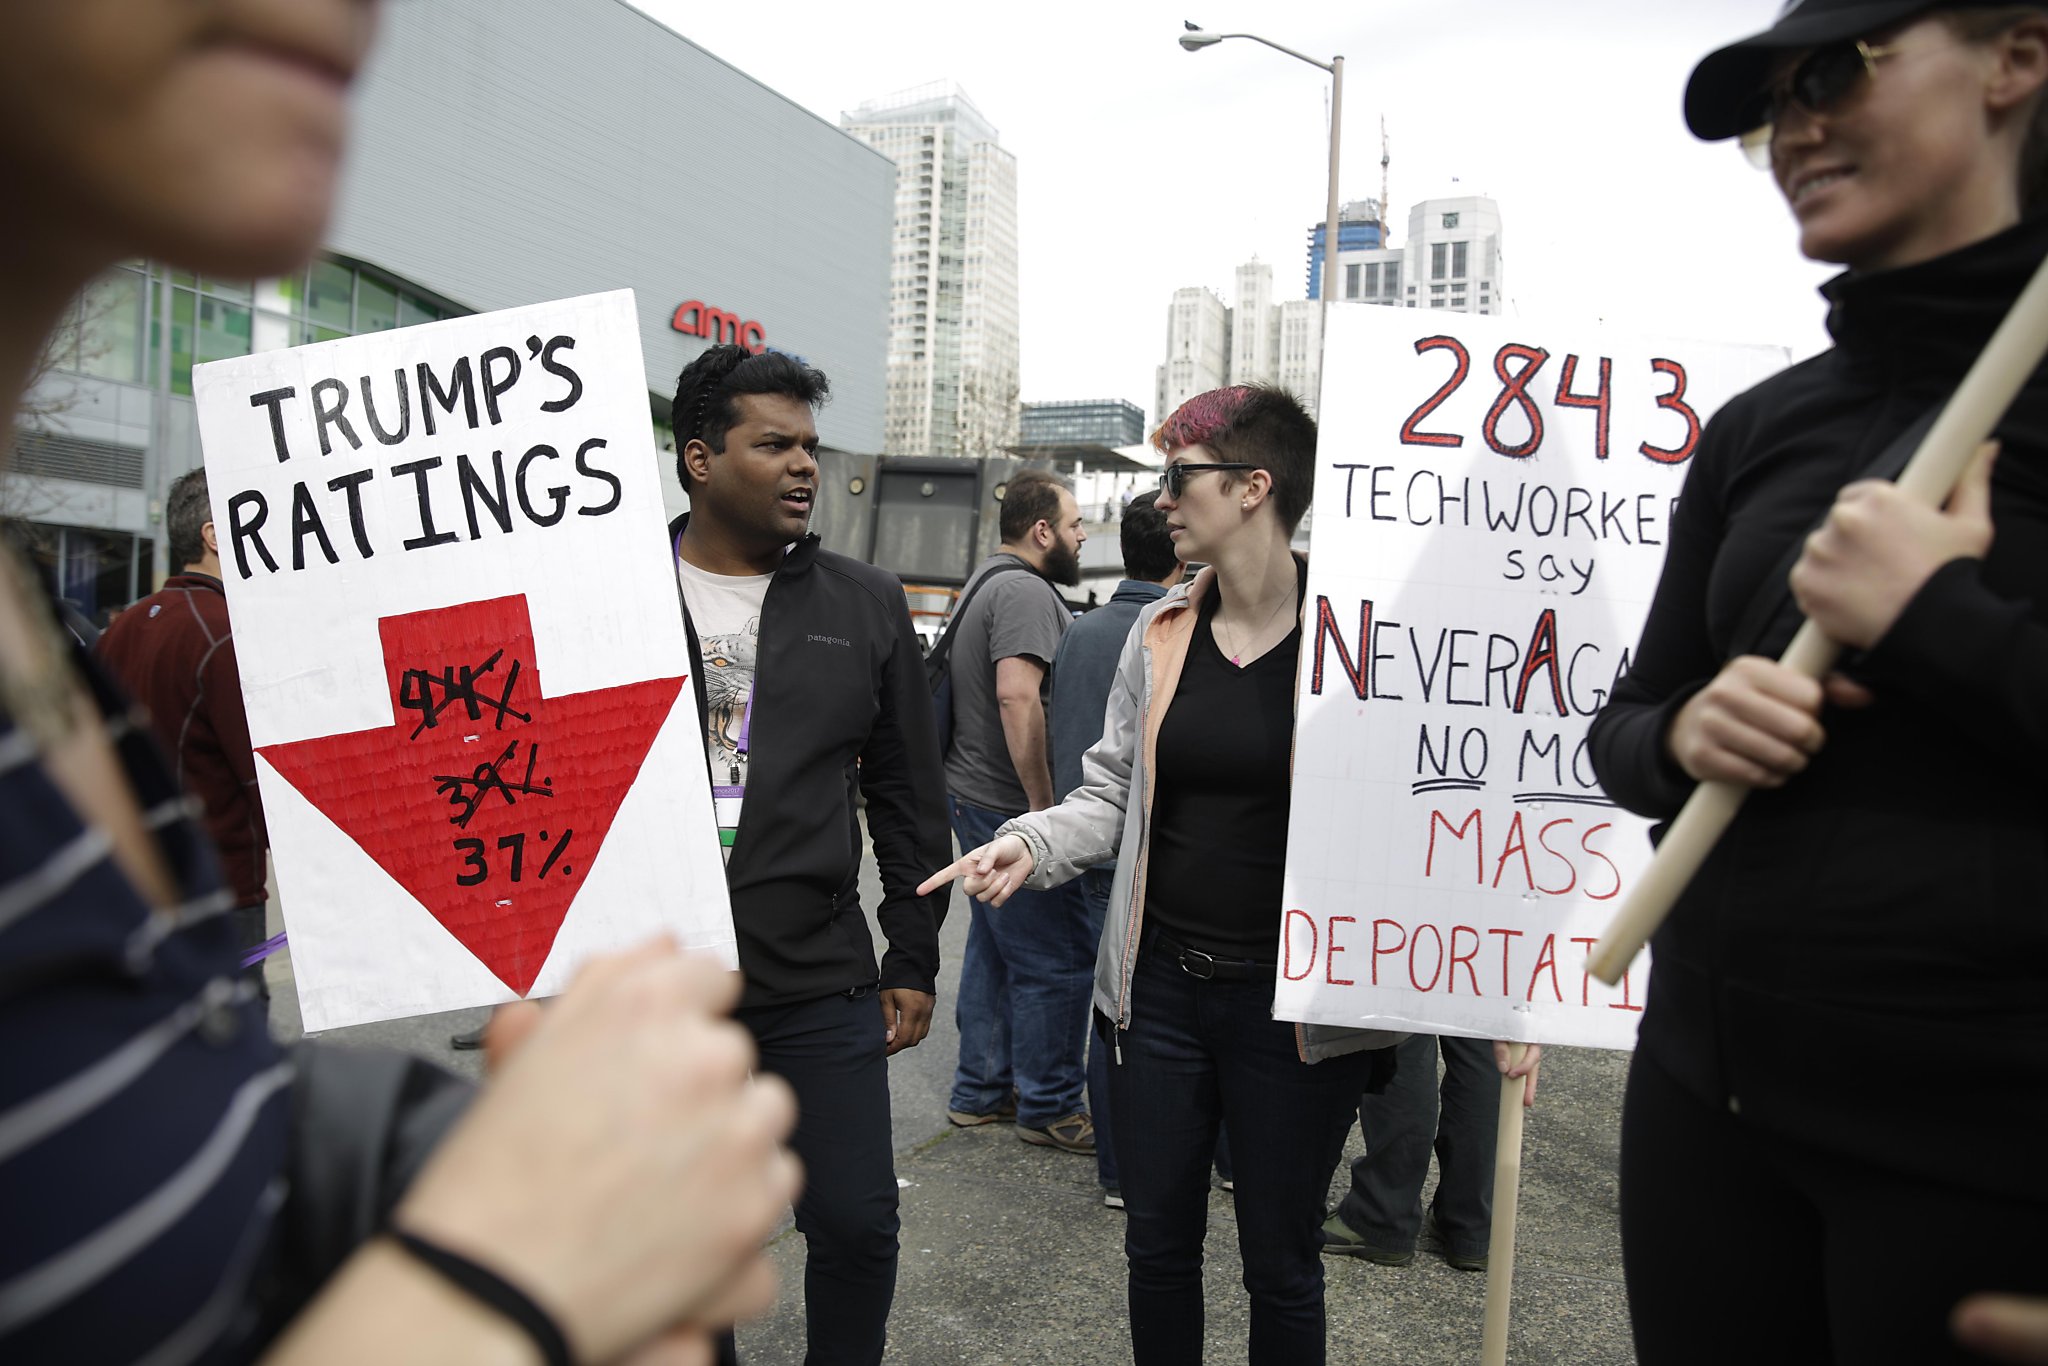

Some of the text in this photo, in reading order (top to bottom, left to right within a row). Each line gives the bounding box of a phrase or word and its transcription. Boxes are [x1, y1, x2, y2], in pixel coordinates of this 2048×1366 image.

[250, 334, 583, 463] TRUMP'S
[1400, 334, 1701, 464] 2843
[228, 437, 622, 579] RATINGS
[1502, 549, 1594, 595] say
[807, 634, 851, 647] patagonia
[1417, 724, 1488, 779] NO
[453, 828, 573, 886] 37%
[1425, 808, 1621, 900] MASS
